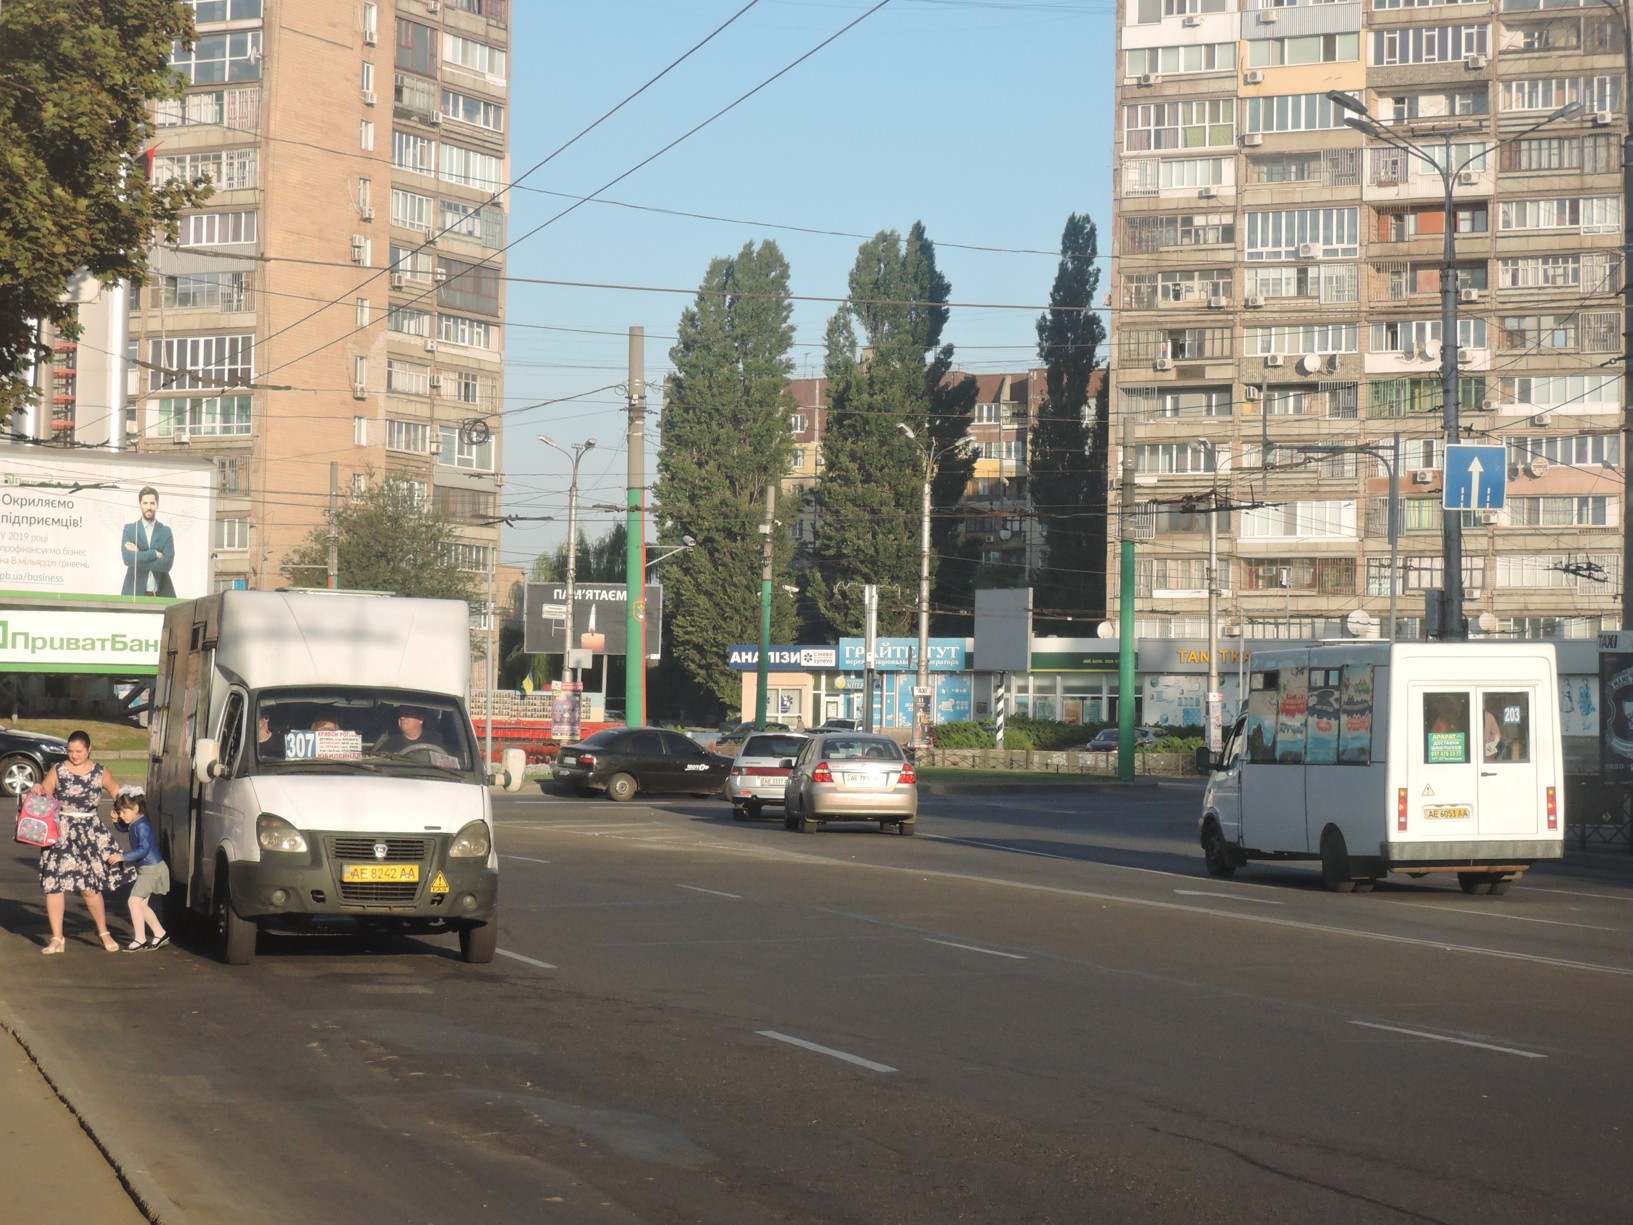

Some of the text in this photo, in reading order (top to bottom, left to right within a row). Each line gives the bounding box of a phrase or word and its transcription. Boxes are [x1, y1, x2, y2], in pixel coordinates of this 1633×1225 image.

[2, 493, 74, 509] Окриляємо
[1, 512, 83, 529] підприємців!
[8, 531, 30, 541] 2019
[31, 533, 48, 543] році
[63, 546, 87, 557] бізнес
[11, 556, 17, 565] 8
[58, 559, 90, 569] гривень
[11, 631, 160, 655] ПриватБан
[1177, 650, 1251, 664] TANTKA
[1504, 707, 1520, 722] 203
[286, 732, 315, 758] 307
[1428, 810, 1439, 818] AE
[353, 868, 416, 879] AE 8242 AA
